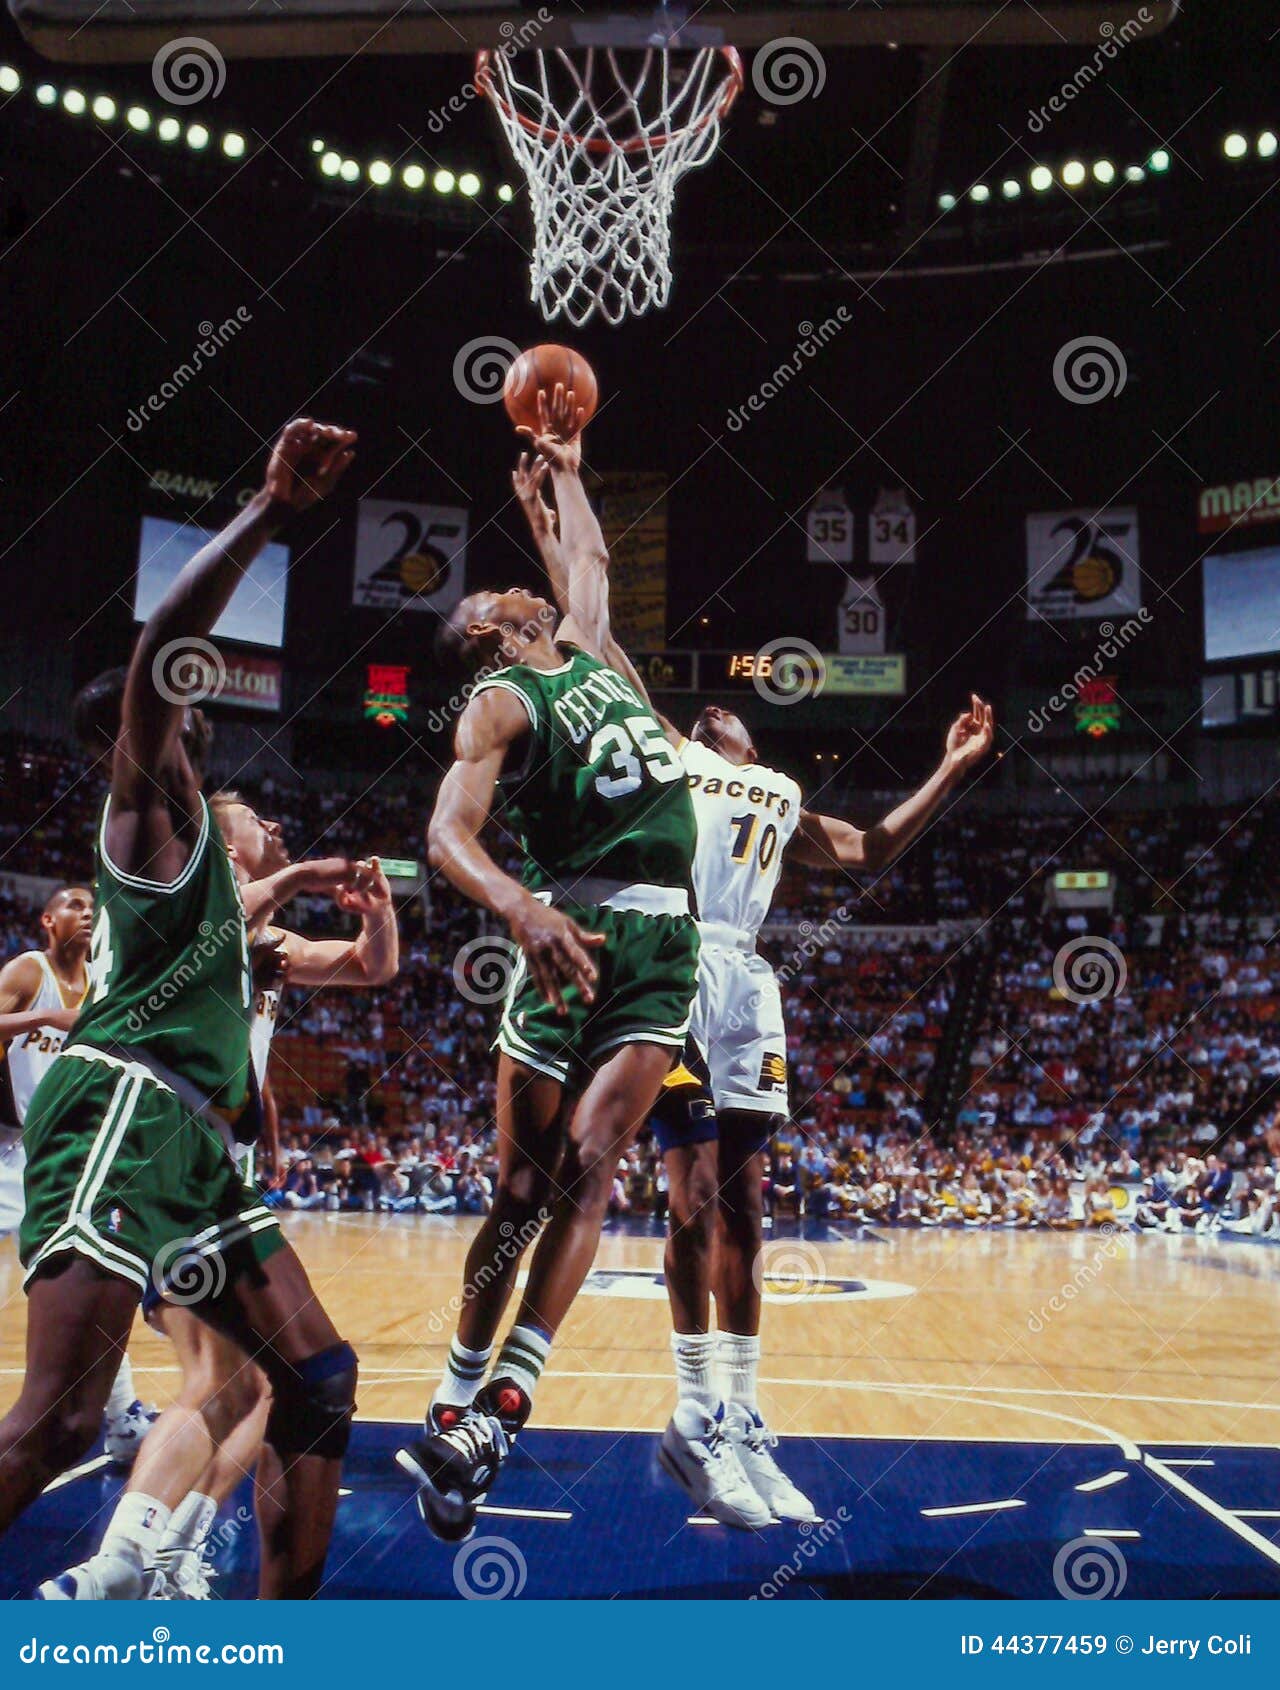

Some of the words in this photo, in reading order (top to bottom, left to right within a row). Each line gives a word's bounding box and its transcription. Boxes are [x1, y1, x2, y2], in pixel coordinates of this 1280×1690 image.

[149, 469, 220, 498] BANK
[814, 519, 847, 543] 35
[876, 519, 909, 544] 34
[371, 510, 460, 597] 25
[1041, 517, 1130, 604] 25
[844, 611, 878, 634] 30
[729, 655, 773, 678] 1:56
[588, 716, 686, 798] 35
[730, 813, 778, 874] 10
